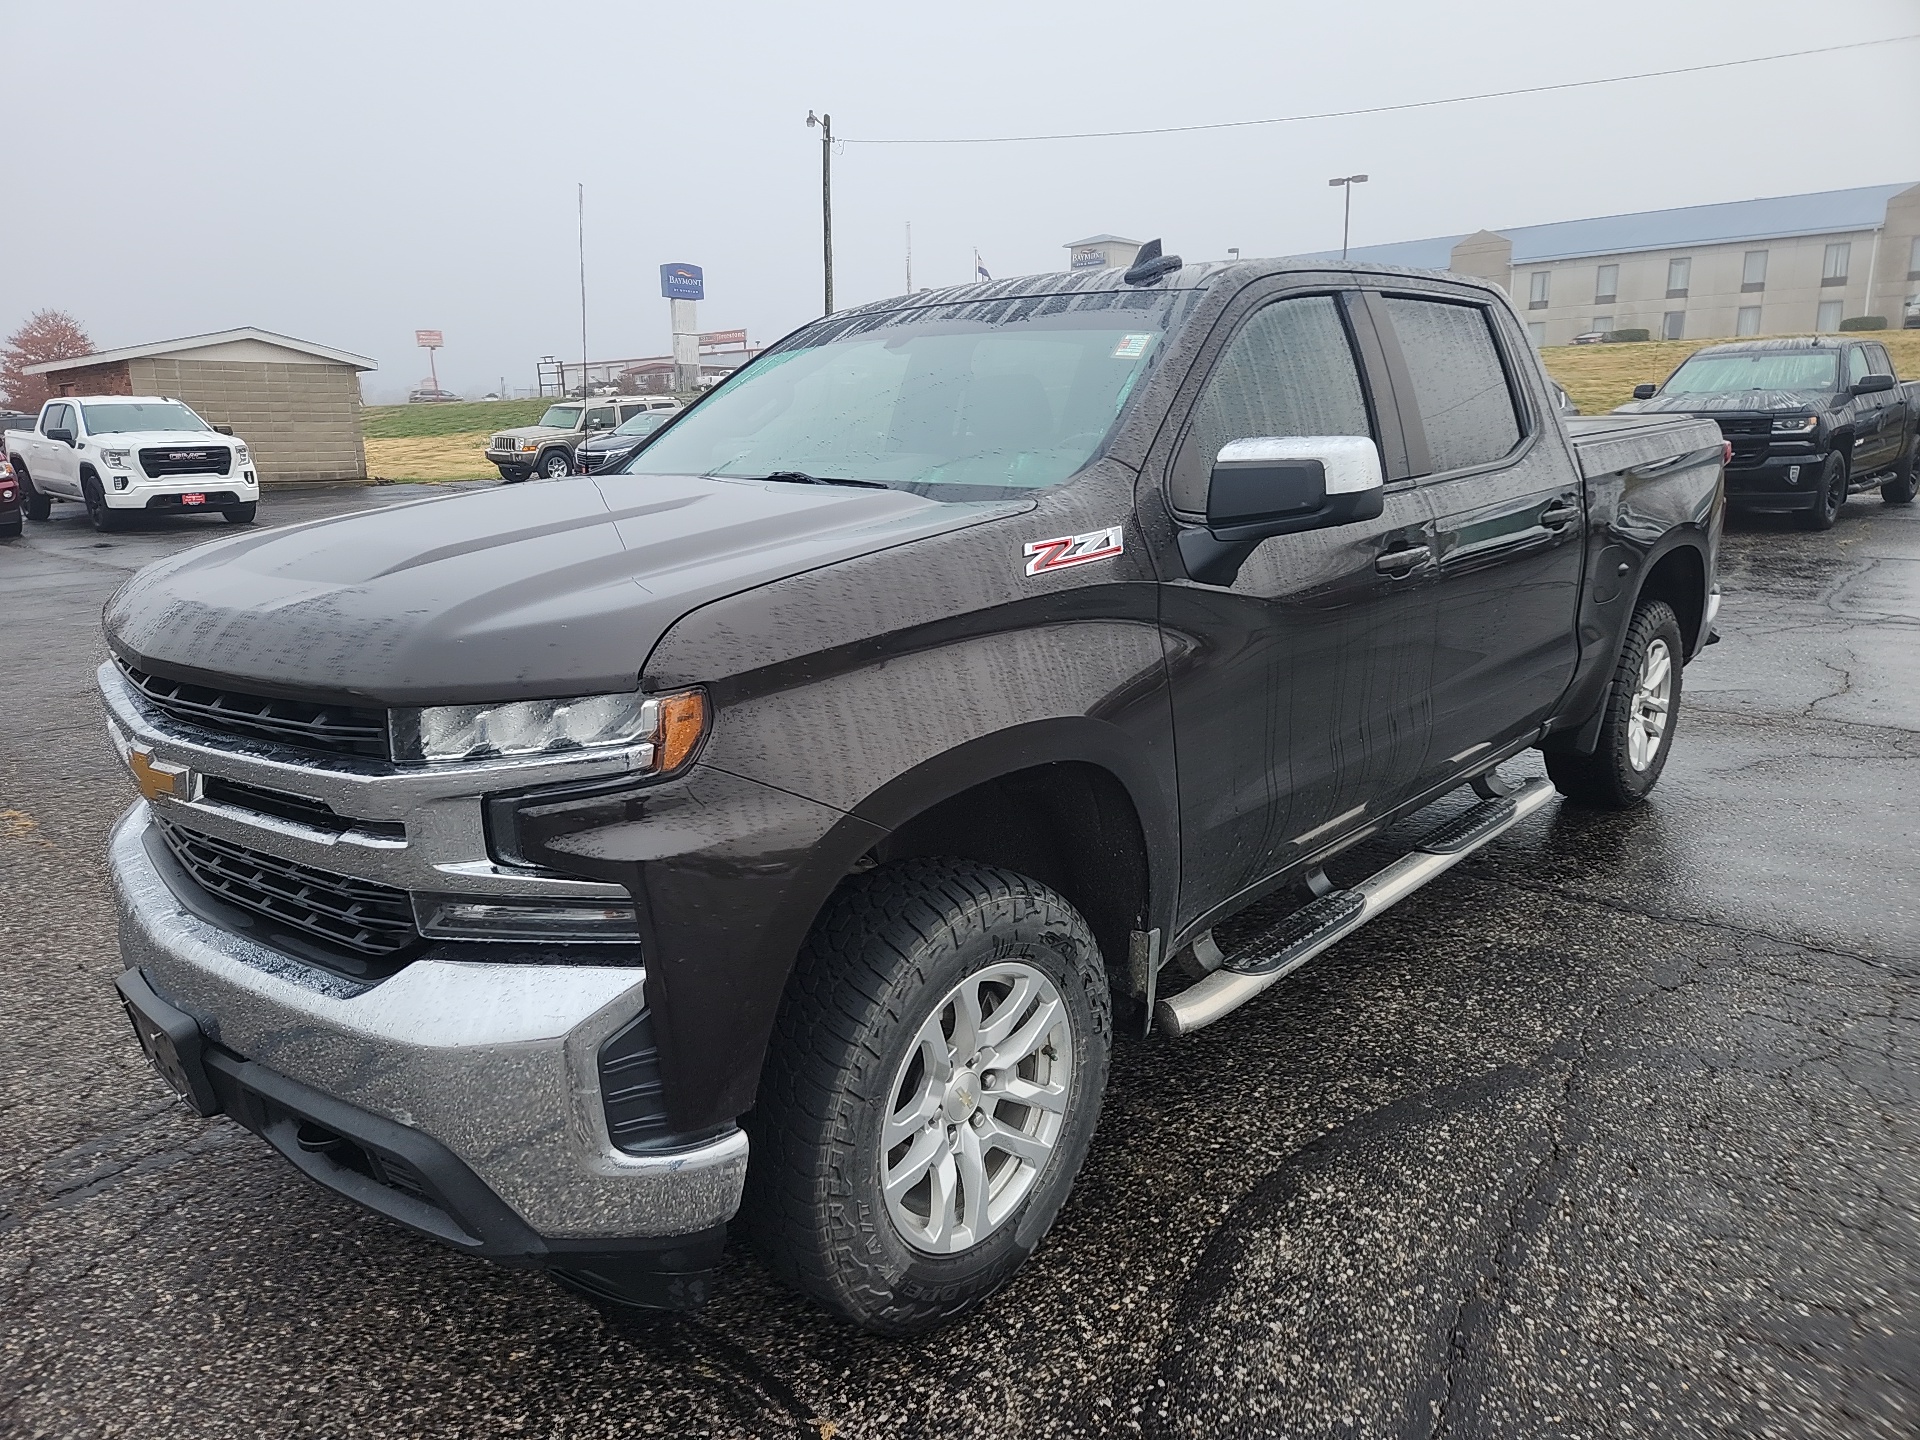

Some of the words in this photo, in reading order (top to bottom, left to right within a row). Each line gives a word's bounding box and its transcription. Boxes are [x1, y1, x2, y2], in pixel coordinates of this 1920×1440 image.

[668, 275, 702, 287] BAYMONT
[169, 452, 207, 460] GMC
[1023, 525, 1123, 577] Z71
